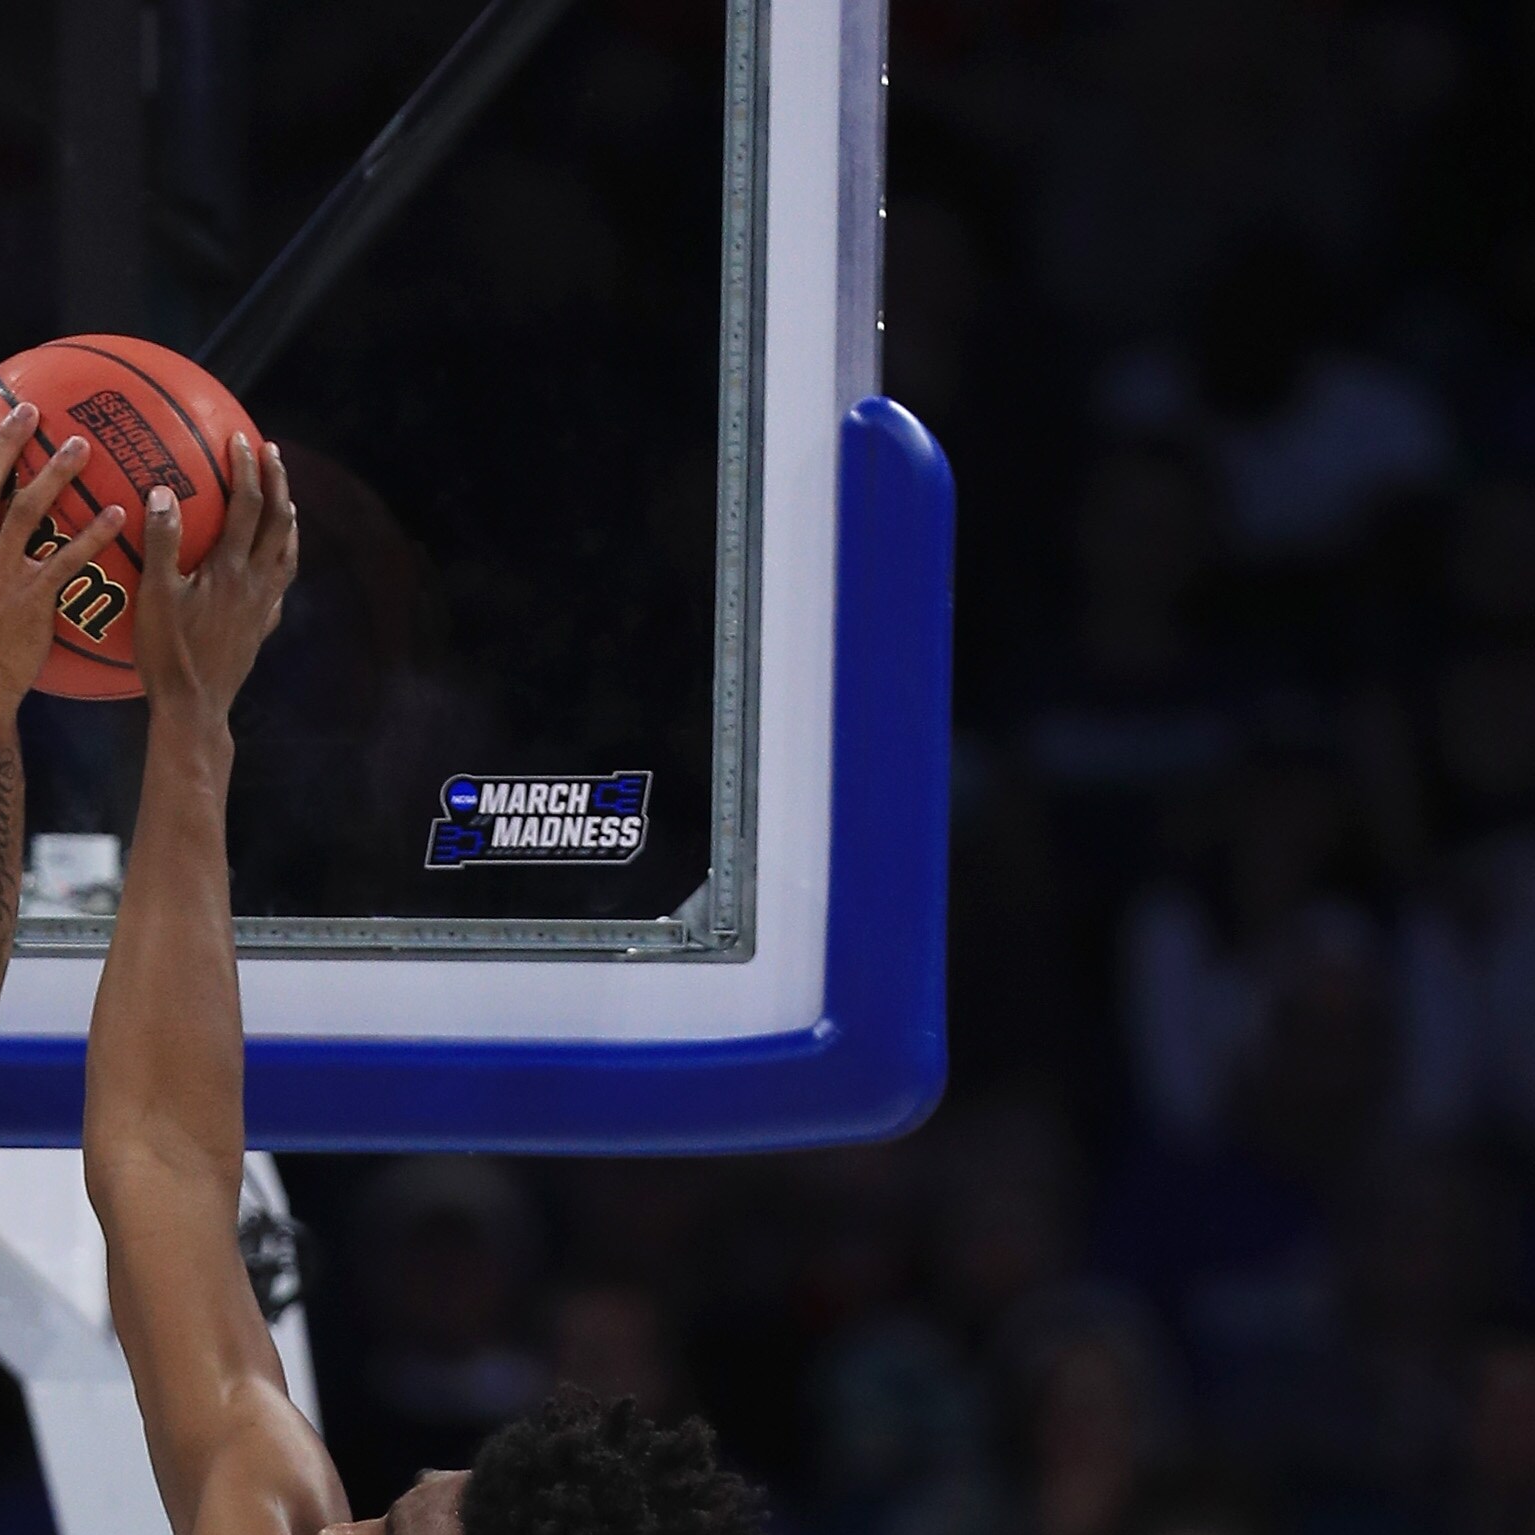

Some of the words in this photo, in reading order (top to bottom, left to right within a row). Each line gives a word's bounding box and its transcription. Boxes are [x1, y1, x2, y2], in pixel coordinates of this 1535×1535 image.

[94, 391, 167, 469] MADNESS
[97, 424, 152, 490] MARCH
[478, 783, 591, 814] MARCH
[491, 816, 642, 848] MADNESS
